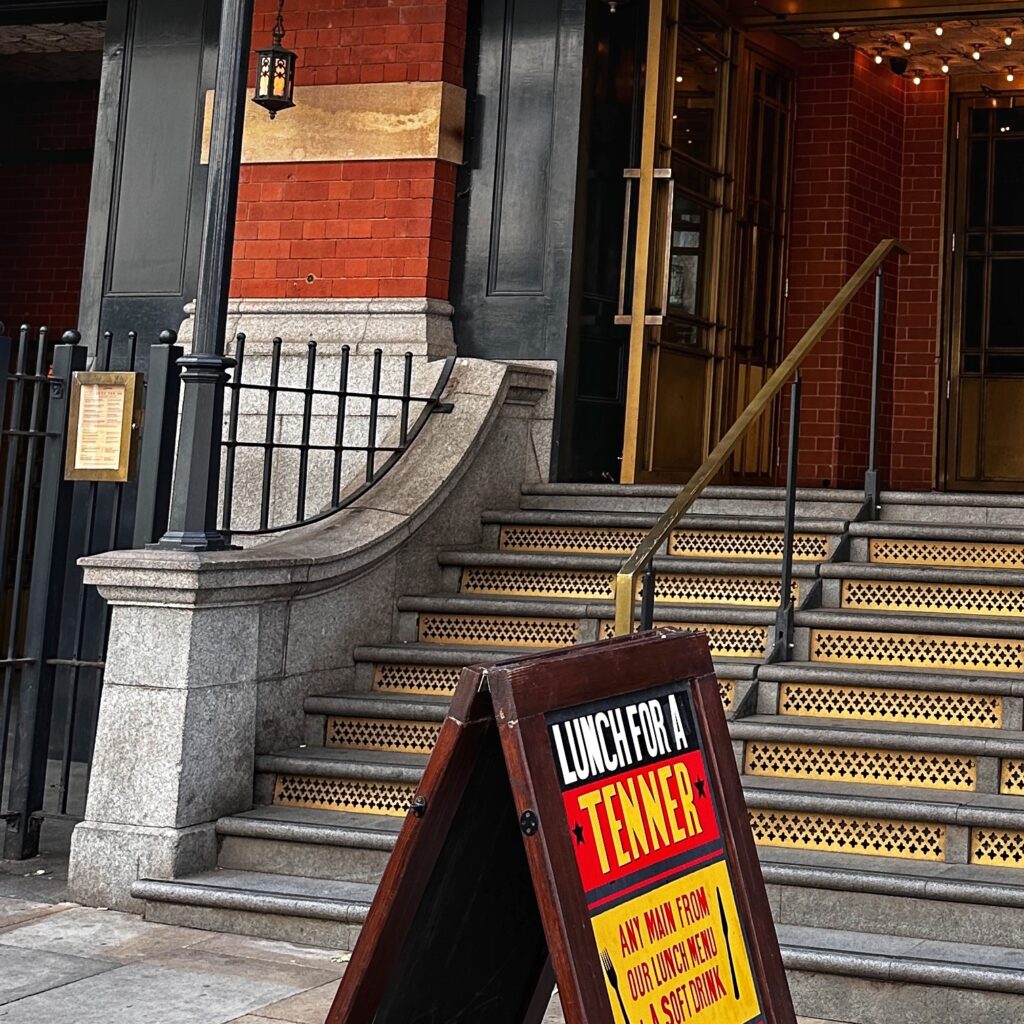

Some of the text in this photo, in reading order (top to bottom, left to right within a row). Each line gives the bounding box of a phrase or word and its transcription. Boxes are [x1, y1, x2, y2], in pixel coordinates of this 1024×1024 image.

[551, 694, 689, 785] LUNCH FOR A
[577, 762, 703, 874] TENNER
[618, 886, 711, 958] ANY MAIN FROM
[626, 926, 718, 1001] OUR LUNCH MENU
[660, 983, 692, 1024] SOFT
[688, 965, 727, 1014] DRINK
